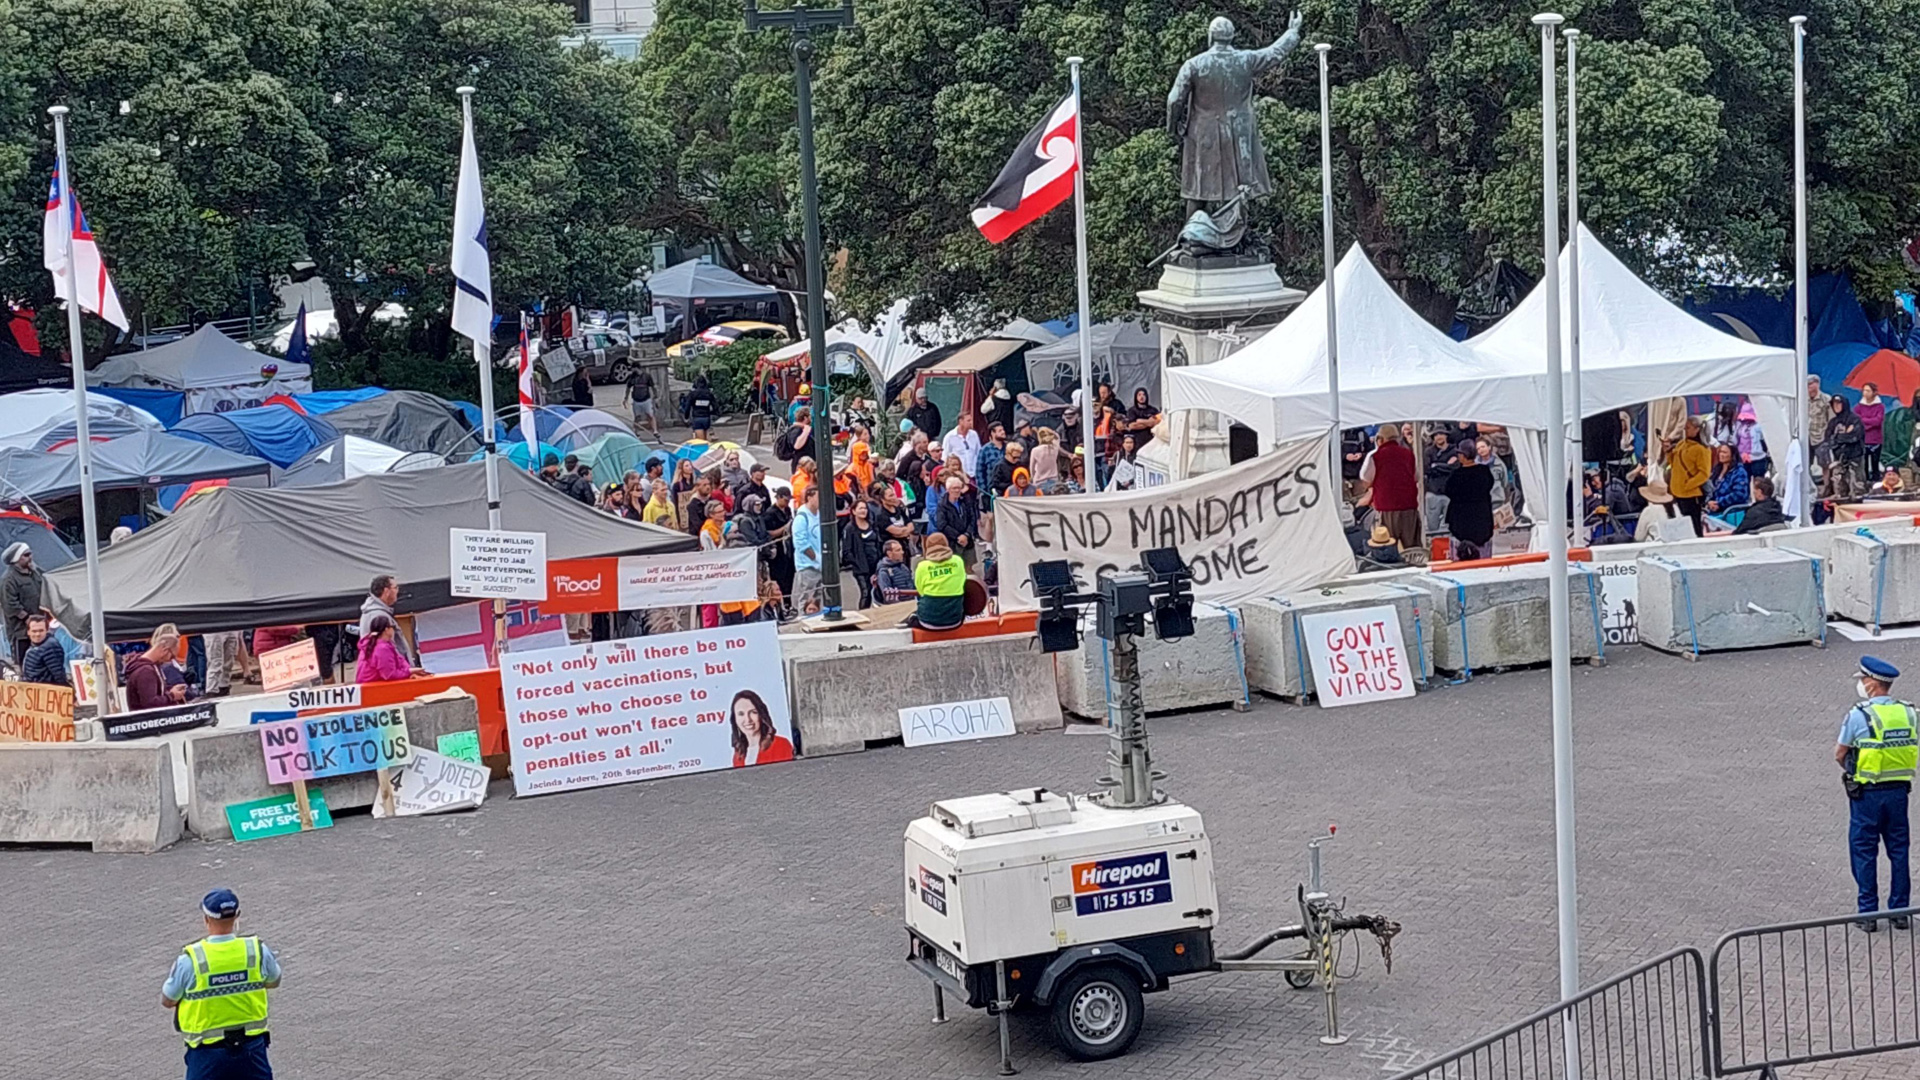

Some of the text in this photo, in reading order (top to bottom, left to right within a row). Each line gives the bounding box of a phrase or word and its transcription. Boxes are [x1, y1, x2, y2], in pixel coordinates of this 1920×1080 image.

[1026, 464, 1320, 550] END MANDATES
[464, 535, 484, 543] THEY
[499, 547, 532, 555] SOCIETY
[662, 565, 682, 573] HAVE
[684, 562, 731, 572] QUESTIONS
[1190, 538, 1269, 586] OME
[482, 585, 517, 593] SUCCEED?
[630, 570, 747, 584] WHERE ARE THEIR ANSWERS?
[1327, 621, 1385, 652] GOVT
[512, 660, 553, 677] "Not
[561, 655, 598, 671] only
[606, 649, 636, 665] will
[644, 644, 689, 660] there
[696, 640, 718, 654] be
[725, 637, 746, 650] no
[1329, 647, 1398, 674] IS THE
[516, 660, 733, 700] forced vaccinations, but
[1328, 667, 1402, 697] VIRUS
[0, 685, 73, 717] UR SILENCE
[288, 686, 355, 708] SMITHY
[519, 688, 707, 724] those who choose to
[0, 711, 74, 742] COMPLIANCE
[109, 711, 210, 734] #FREETOBECHURCH.NZ
[266, 709, 403, 747] NO VIOLENCE
[522, 710, 726, 749] opt-out won't face any
[910, 701, 1004, 740] AROHA
[340, 739, 378, 764] TO
[381, 736, 408, 761] US
[526, 738, 672, 775] penalties at all."
[390, 769, 404, 792] 4
[415, 776, 453, 803] YOU
[440, 760, 485, 789] VOTED
[528, 758, 701, 790] Jacinda Ardern, 20th September, 2020
[240, 809, 319, 833] PLAY SPOT
[249, 801, 300, 819] FREE TO
[1081, 858, 1161, 886] Hirepool
[1102, 894, 1118, 909] 15
[1121, 891, 1137, 906] 15
[1139, 888, 1154, 903] 15
[211, 973, 246, 984] POLICE
